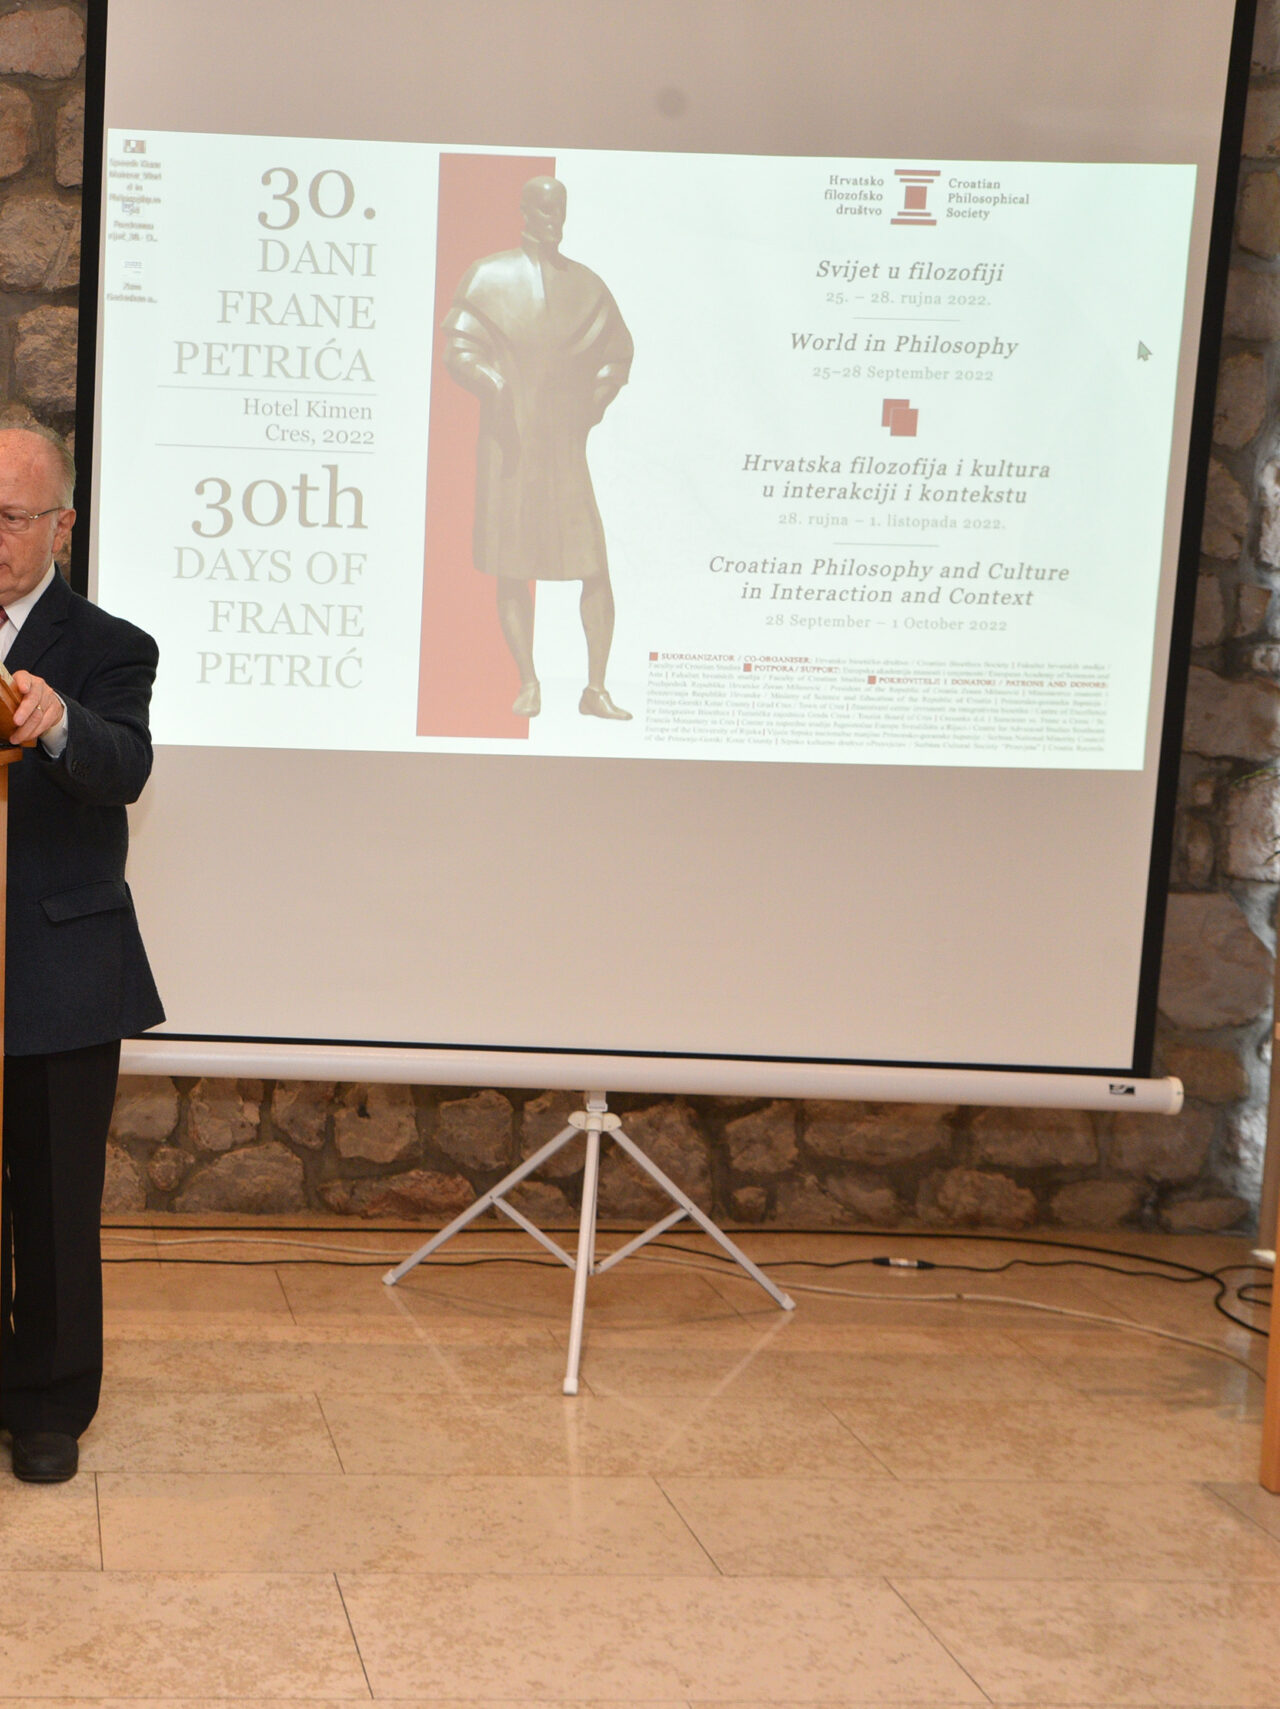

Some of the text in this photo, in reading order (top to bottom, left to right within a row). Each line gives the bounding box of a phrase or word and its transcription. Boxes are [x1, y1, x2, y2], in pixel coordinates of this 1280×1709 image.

[829, 174, 885, 187] Hrvatsko
[948, 177, 1001, 190] Croatian
[257, 166, 376, 231] 30.
[824, 188, 884, 202] filozofsko
[947, 192, 1030, 207] Philosophical
[835, 203, 883, 216] društvo
[945, 207, 991, 221] Society
[256, 238, 377, 277] DANI
[815, 259, 1005, 286] Svijet u filozofiji
[216, 289, 376, 330] FRANE
[825, 292, 849, 305] 25.
[870, 290, 895, 304] 28.
[900, 291, 942, 308] rujna
[947, 294, 991, 306] 2022.
[791, 332, 1019, 360] World in Philosophy
[173, 337, 375, 383] PETRIĆA
[866, 364, 951, 382] September
[954, 369, 994, 382] 2022
[243, 397, 372, 420] Hotel Kimen
[265, 423, 375, 445] Cres, 2022
[741, 454, 1051, 481] Hrvatska filozofija i kultura
[191, 463, 369, 539] 30th
[762, 480, 1027, 505] u interakciji i kontekstu
[778, 511, 802, 525] 28.
[808, 512, 849, 529] rujna
[887, 513, 957, 532] listopada
[962, 518, 1006, 530] 2022.
[173, 546, 368, 586] DAYS OF
[709, 555, 1070, 583] Croatian Philosophy and Culture
[741, 581, 1034, 606] in Interaction and Context
[207, 599, 365, 638] FRANE
[765, 613, 785, 626] 28
[789, 613, 872, 630] September
[903, 616, 965, 631] October
[969, 620, 1008, 632] 2022
[196, 646, 363, 689] PETRIĆ
